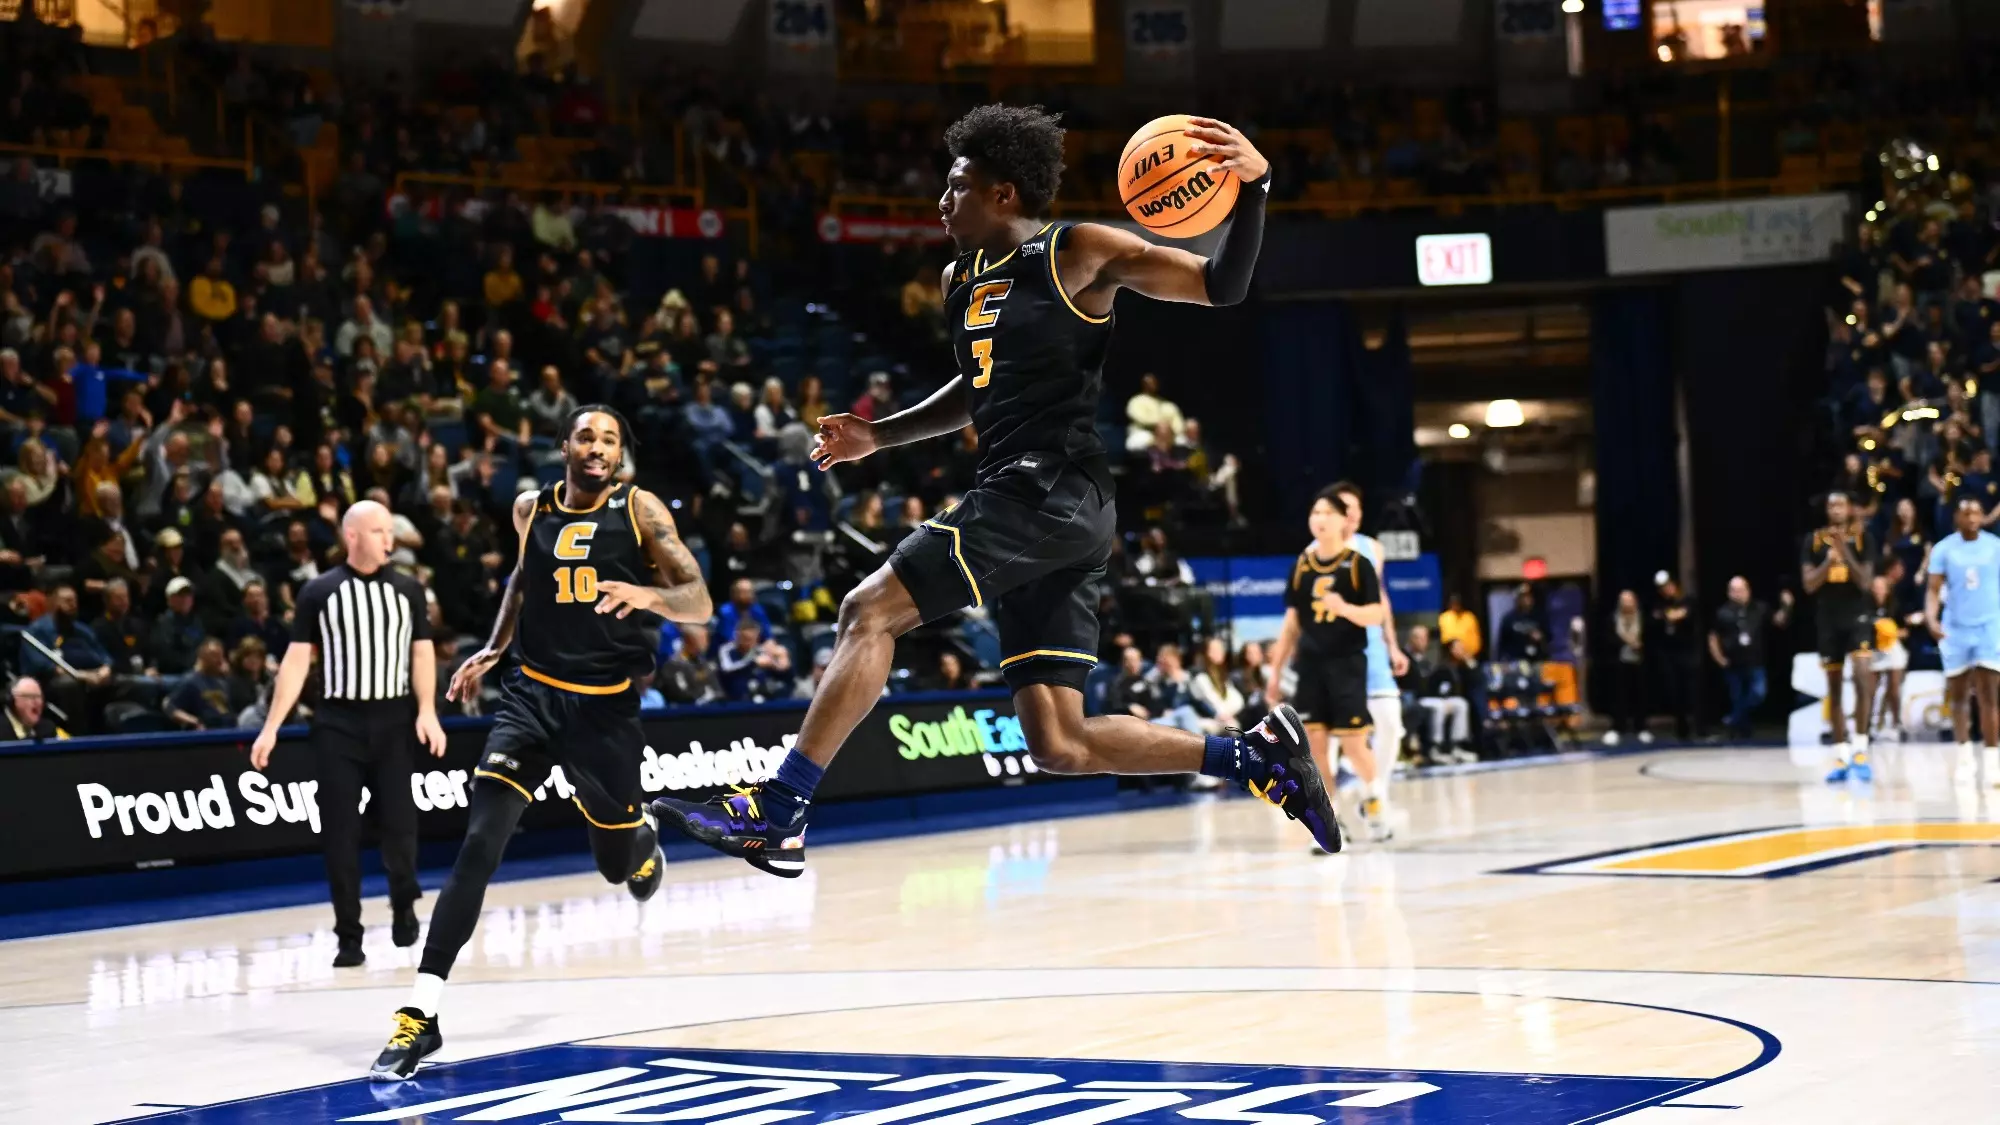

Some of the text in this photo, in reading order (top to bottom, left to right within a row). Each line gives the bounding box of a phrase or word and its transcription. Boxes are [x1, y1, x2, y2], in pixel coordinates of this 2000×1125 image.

[1138, 170, 1216, 218] Wilson
[1424, 242, 1482, 281] EXIT
[964, 278, 1014, 331] C
[971, 337, 994, 389] 3
[553, 521, 599, 560] C
[552, 565, 599, 603] 10
[888, 705, 1028, 760] SouthEas
[76, 773, 236, 839] Proud
[238, 769, 468, 835] Supter
